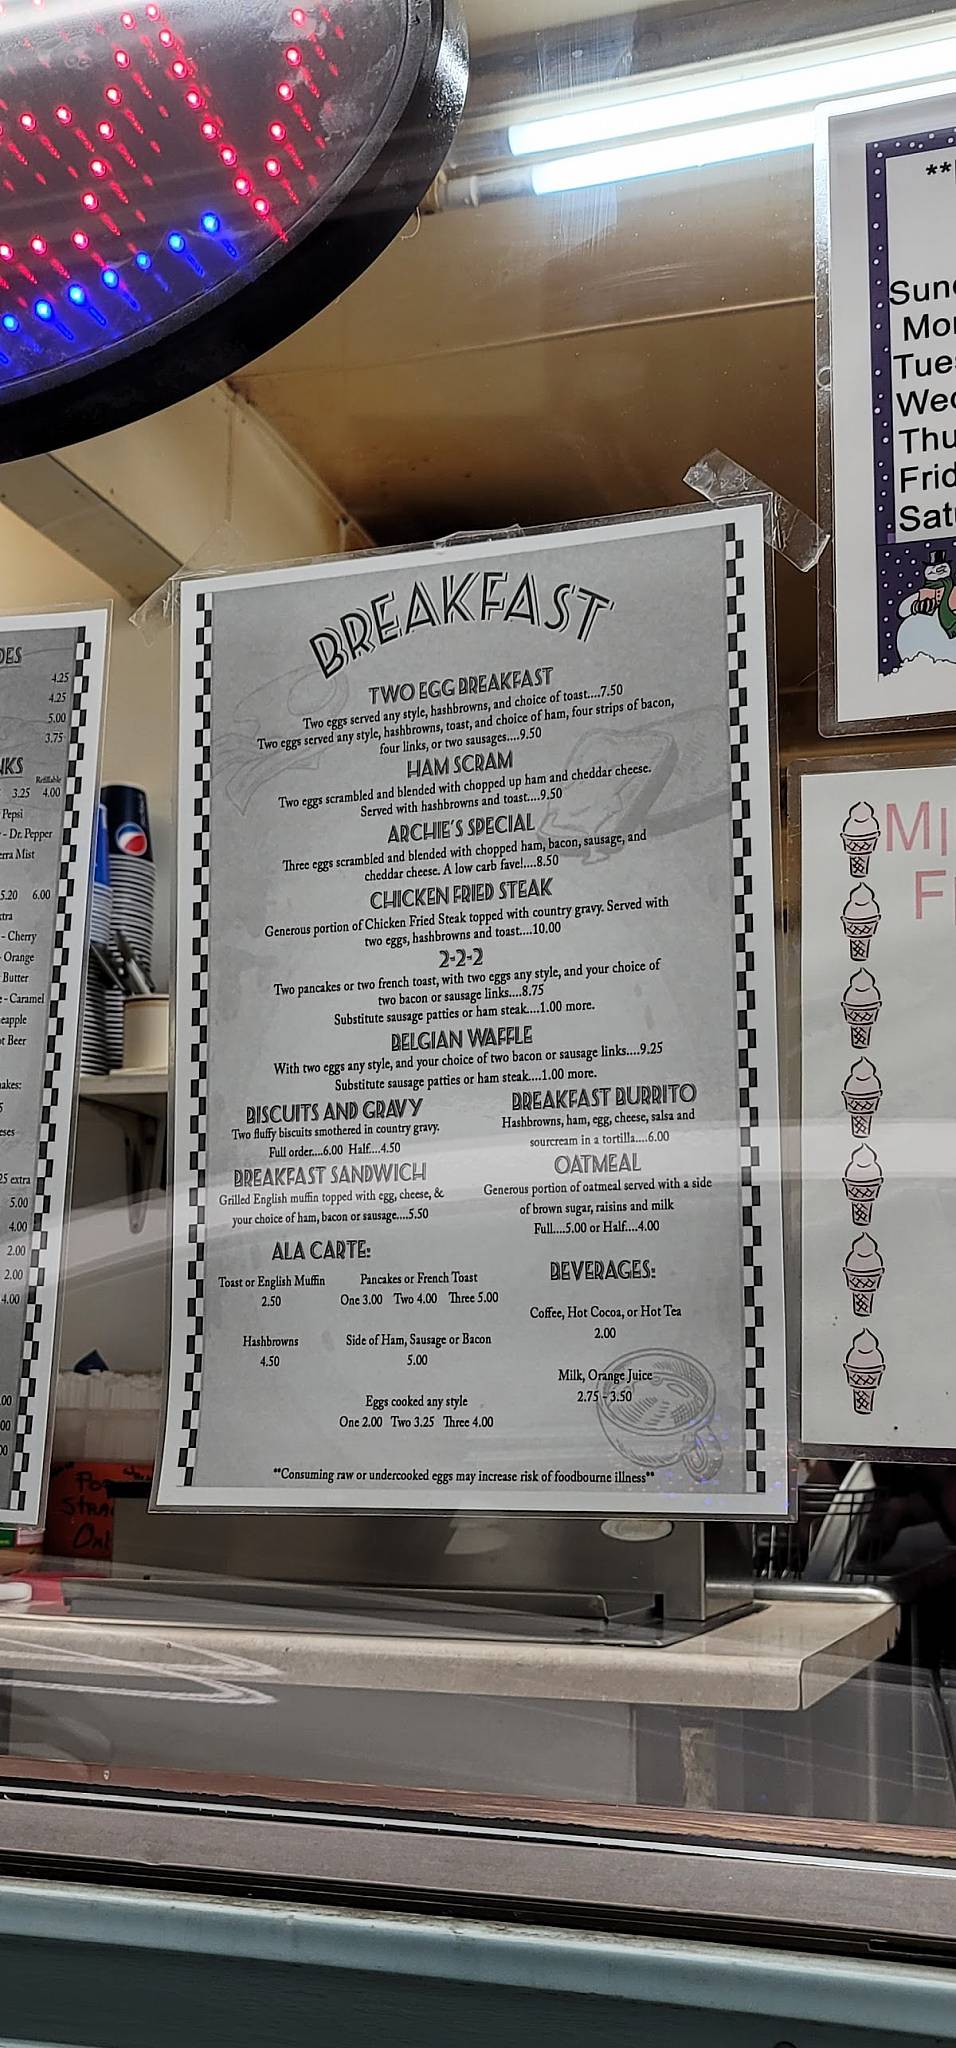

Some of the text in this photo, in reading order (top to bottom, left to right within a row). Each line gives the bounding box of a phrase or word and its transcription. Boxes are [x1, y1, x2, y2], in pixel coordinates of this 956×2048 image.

[889, 279, 956, 305] Sun
[893, 353, 956, 379] Tue
[899, 501, 956, 532] Sat
[309, 571, 614, 679] BREAKFAST
[52, 672, 69, 683] 4.25
[368, 667, 554, 705] TWO EGG BREAKFAST
[48, 692, 66, 702] 4.25
[302, 684, 623, 731] Two eggs served any style, hashbrowns, and choice of toast....7.50
[48, 712, 66, 723] 5.00
[45, 732, 63, 743] 3.75
[380, 726, 541, 754] four links, or two sausages....9.50
[408, 750, 513, 778] HAM SCRAM
[36, 775, 62, 784] Refillable
[12, 787, 60, 798] 3.25 4.00
[361, 787, 562, 817] Served with hashbrowns and toast....9.50
[2, 809, 23, 823] Pepsi
[9, 828, 53, 842] Dr. Pepper
[388, 813, 535, 844] ARCHIE'S SPECIAL
[0, 848, 35, 860] erra Mist
[32, 889, 51, 900] 6.00
[370, 877, 553, 910] CHICKEN FRIED STEAK
[8, 931, 37, 944] Cherry
[4, 951, 35, 965] Orange
[439, 947, 483, 968] 2-2-2
[2, 972, 29, 983] Butter
[9, 993, 45, 1004] Caramel
[378, 983, 544, 1006] two bacon or sausage links....8.75
[1, 1013, 27, 1028] eapple
[8, 1034, 27, 1046] Beer
[392, 1025, 533, 1052] BELGIAN WAFFLE
[512, 1083, 697, 1111] BREAKFAST BURRITO
[246, 1098, 423, 1124] BISCUITS AND GRAVY
[530, 1137, 578, 1147] sourcream
[581, 1134, 591, 1145] in
[602, 1130, 670, 1144] tortilla....6.00
[269, 1141, 400, 1158] Full order....6.00 Half....4.50
[554, 1152, 642, 1175] OATMEAL
[11, 1175, 30, 1184] extra
[234, 1163, 426, 1188] BREAKFAST SANDWICH
[9, 1197, 28, 1208] 5.00
[9, 1221, 27, 1232] 4.00
[534, 1220, 659, 1234] Full....5.00 or Half....4.00
[7, 1245, 26, 1256] 2.00
[272, 1240, 371, 1261] ALA CARTE:
[4, 1269, 23, 1280] 2.00
[550, 1260, 656, 1281] BEVERAGES:
[218, 1276, 243, 1288] Toast
[258, 1275, 292, 1290] English
[294, 1274, 325, 1286] Muffin
[360, 1271, 478, 1285] Pancakes or French Toast
[1, 1293, 20, 1304] 4.00
[262, 1295, 281, 1307] 2.50
[340, 1291, 498, 1305] One 3.00 Two 4.00 Three 5.00
[530, 1304, 682, 1320] Coffee, Hot Cocoa, or Hot Tea
[594, 1327, 616, 1339] 2.00
[243, 1336, 298, 1347] Hashbrowns
[346, 1334, 366, 1346] Side
[368, 1334, 380, 1346] of
[381, 1334, 407, 1348] Ham,
[410, 1333, 446, 1349] Sausage
[462, 1332, 491, 1344] Bacon
[260, 1355, 280, 1367] 4.50
[407, 1354, 428, 1365] 5.00
[558, 1369, 653, 1384] Milk, Orange Juice
[365, 1394, 468, 1411] Eggs cooked any style
[577, 1390, 599, 1402] 2.75
[610, 1390, 632, 1402] 3.50
[340, 1415, 494, 1428] One 2.00 Two 3.25 Three 4.00
[336, 1472, 354, 1480] raw
[356, 1472, 367, 1480] or
[369, 1468, 429, 1481] undercooked
[432, 1473, 453, 1485] eggs
[456, 1473, 476, 1485] may
[478, 1470, 517, 1482] increase
[520, 1470, 539, 1482] risk
[541, 1470, 553, 1482] of
[554, 1470, 612, 1483] foodbourne
